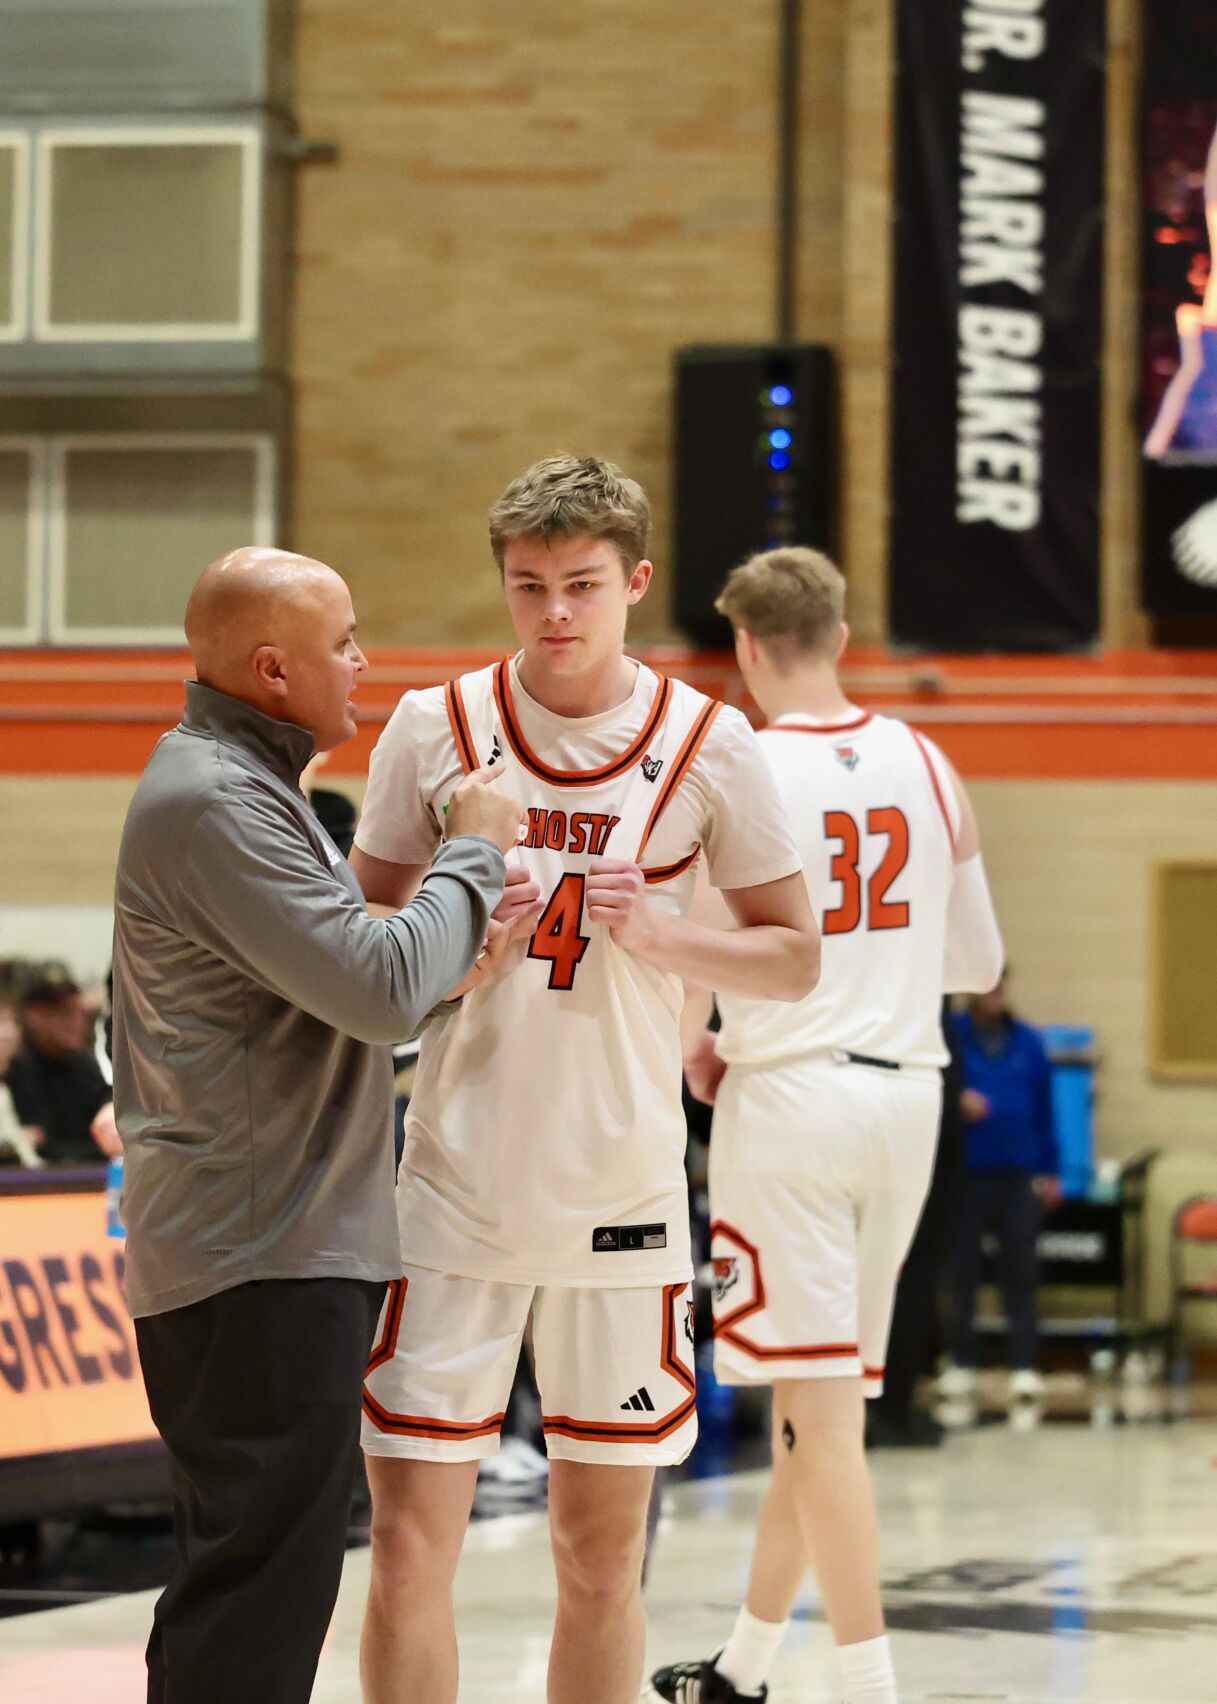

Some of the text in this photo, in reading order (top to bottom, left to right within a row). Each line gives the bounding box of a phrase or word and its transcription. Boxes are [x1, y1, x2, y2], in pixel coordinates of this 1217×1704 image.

[956, 0, 1046, 531] R. MARK BAKER
[526, 872, 591, 990] 4
[822, 806, 910, 935] 32
